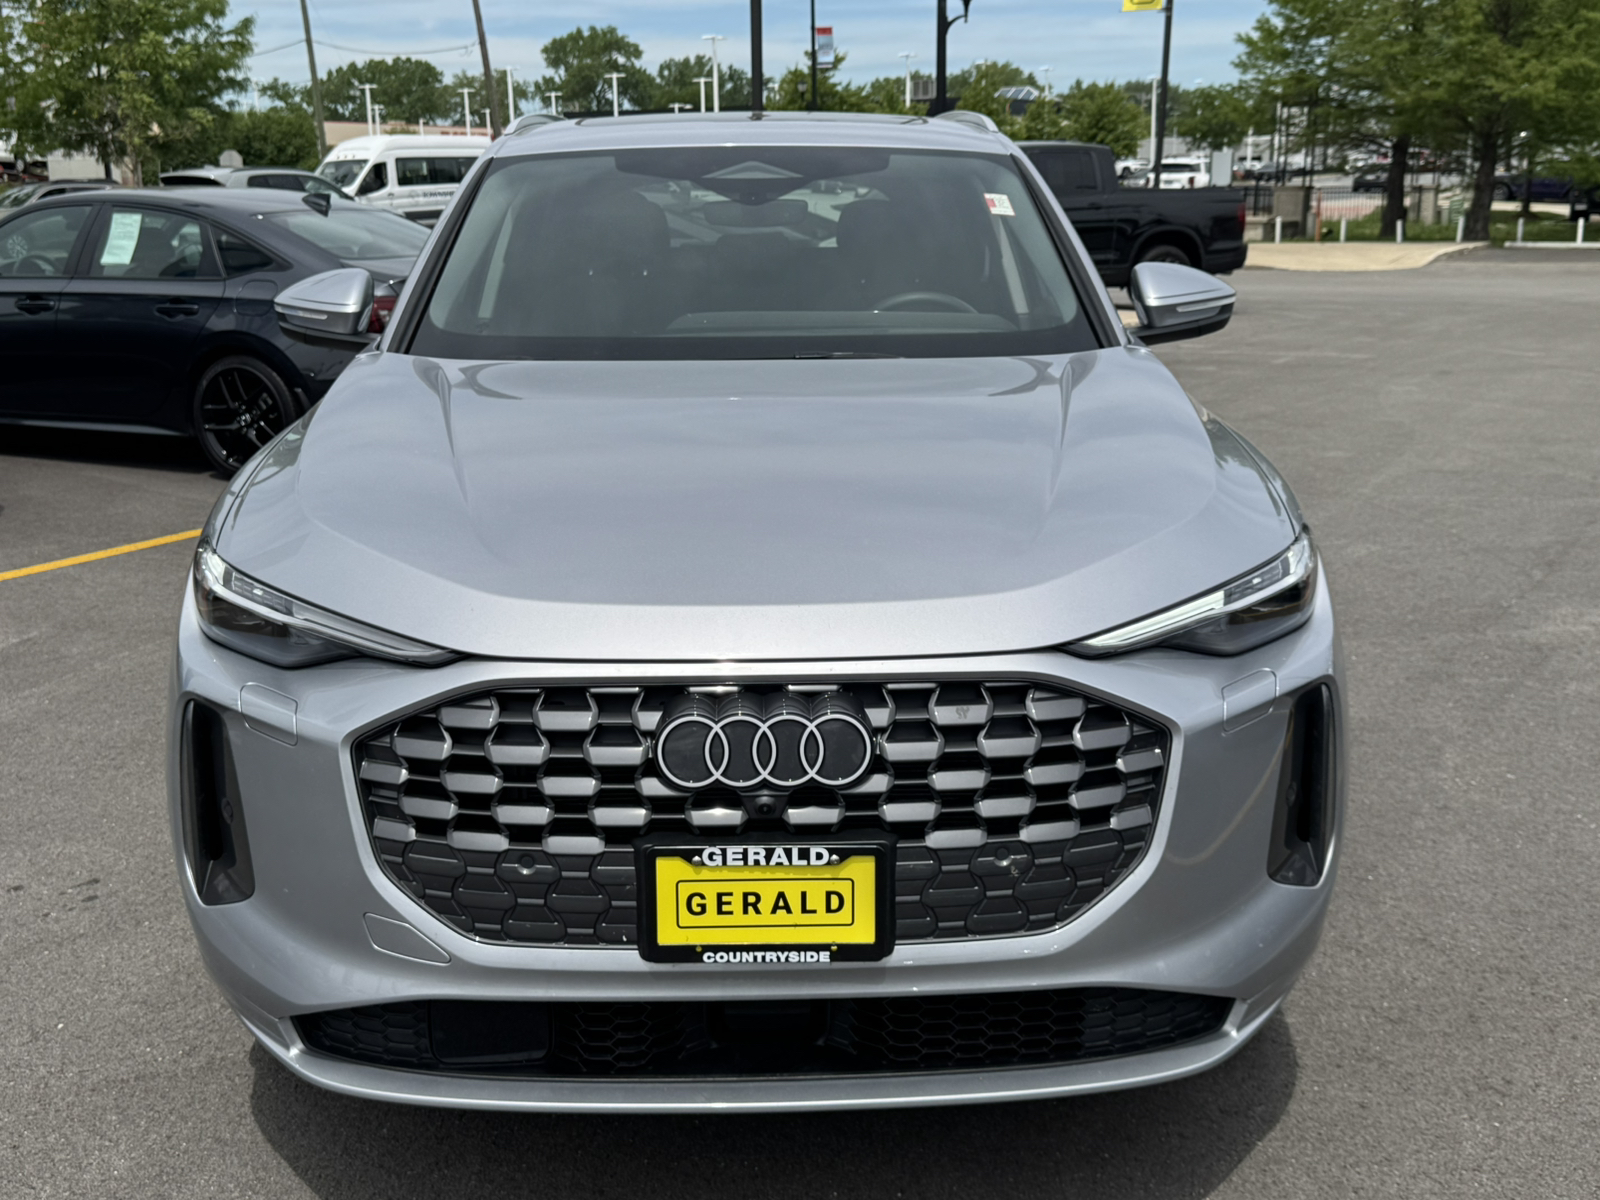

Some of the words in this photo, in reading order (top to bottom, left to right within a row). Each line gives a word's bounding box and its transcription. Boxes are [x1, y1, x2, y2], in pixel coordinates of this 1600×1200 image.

[702, 847, 830, 866] GERALD
[686, 891, 845, 916] GERALD
[702, 951, 831, 963] COUNTRYSIDE
